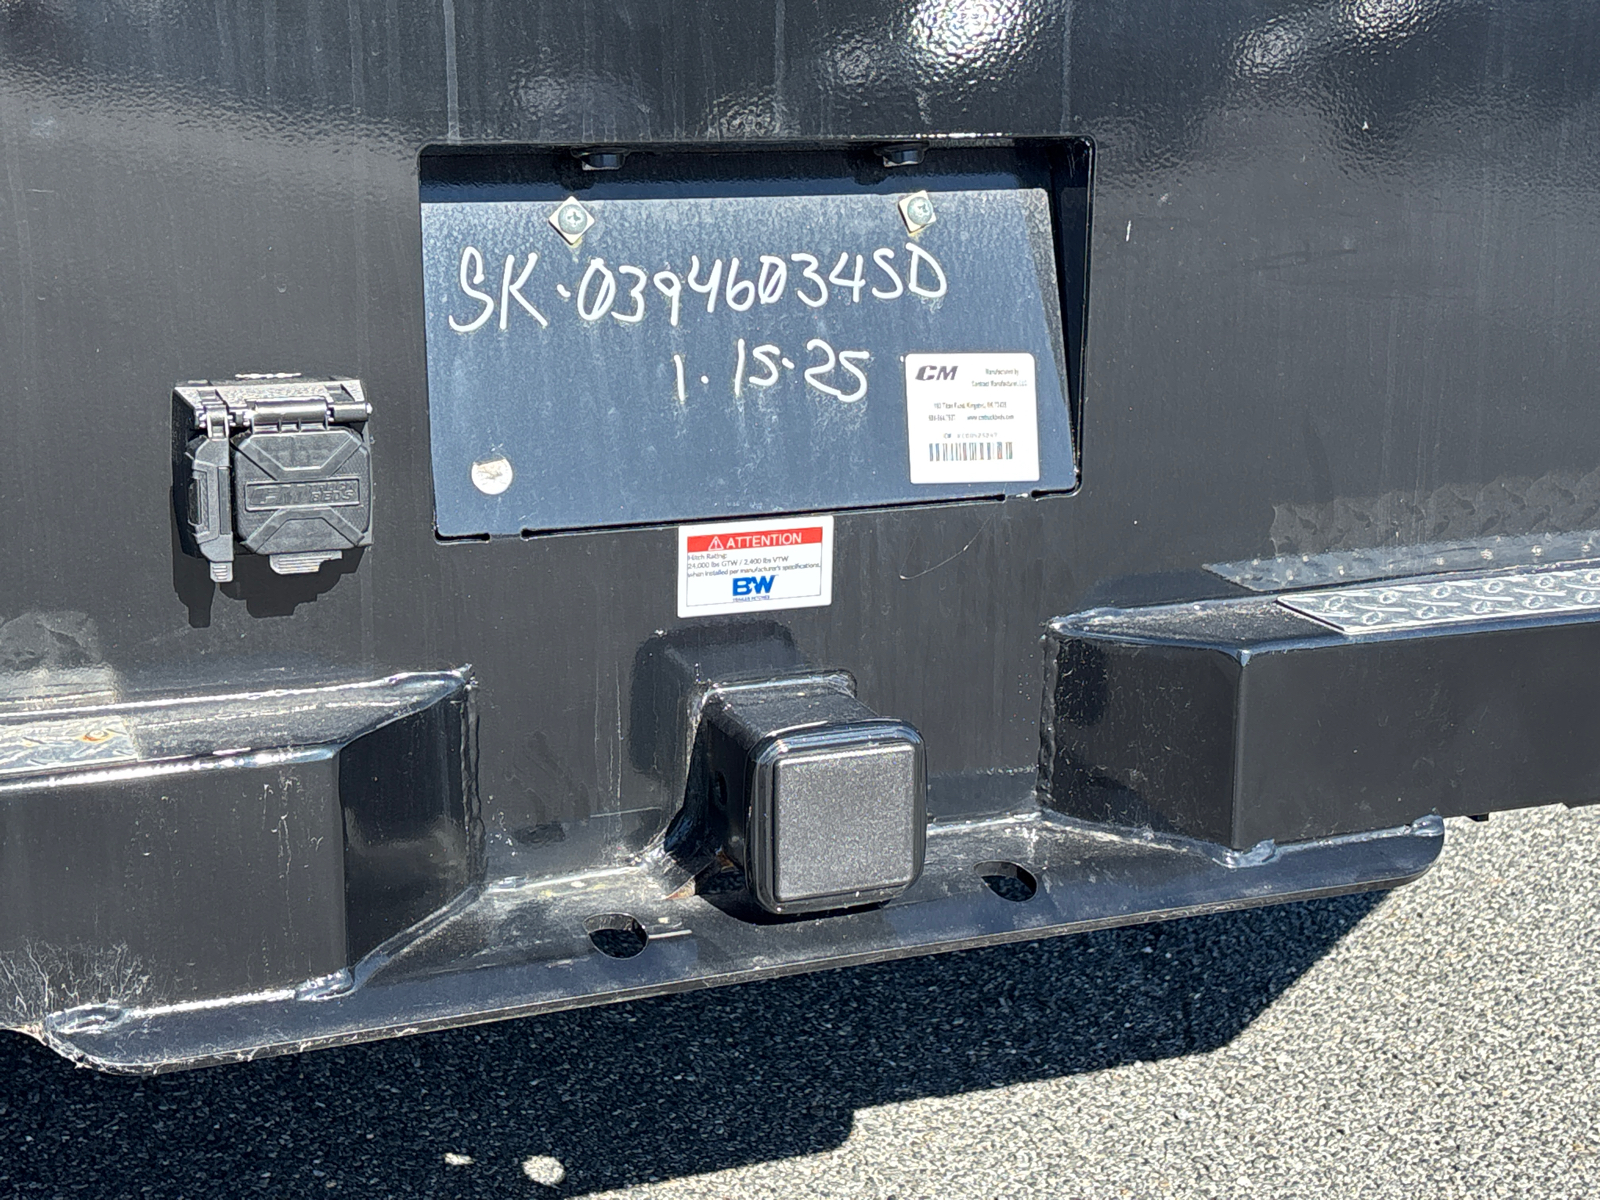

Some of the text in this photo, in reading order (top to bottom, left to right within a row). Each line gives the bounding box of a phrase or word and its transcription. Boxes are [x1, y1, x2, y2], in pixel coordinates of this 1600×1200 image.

[915, 365, 958, 381] CM
[726, 532, 802, 549] ATTENTION
[721, 559, 739, 567] GTW
[705, 568, 728, 576] installed
[729, 568, 739, 576] per
